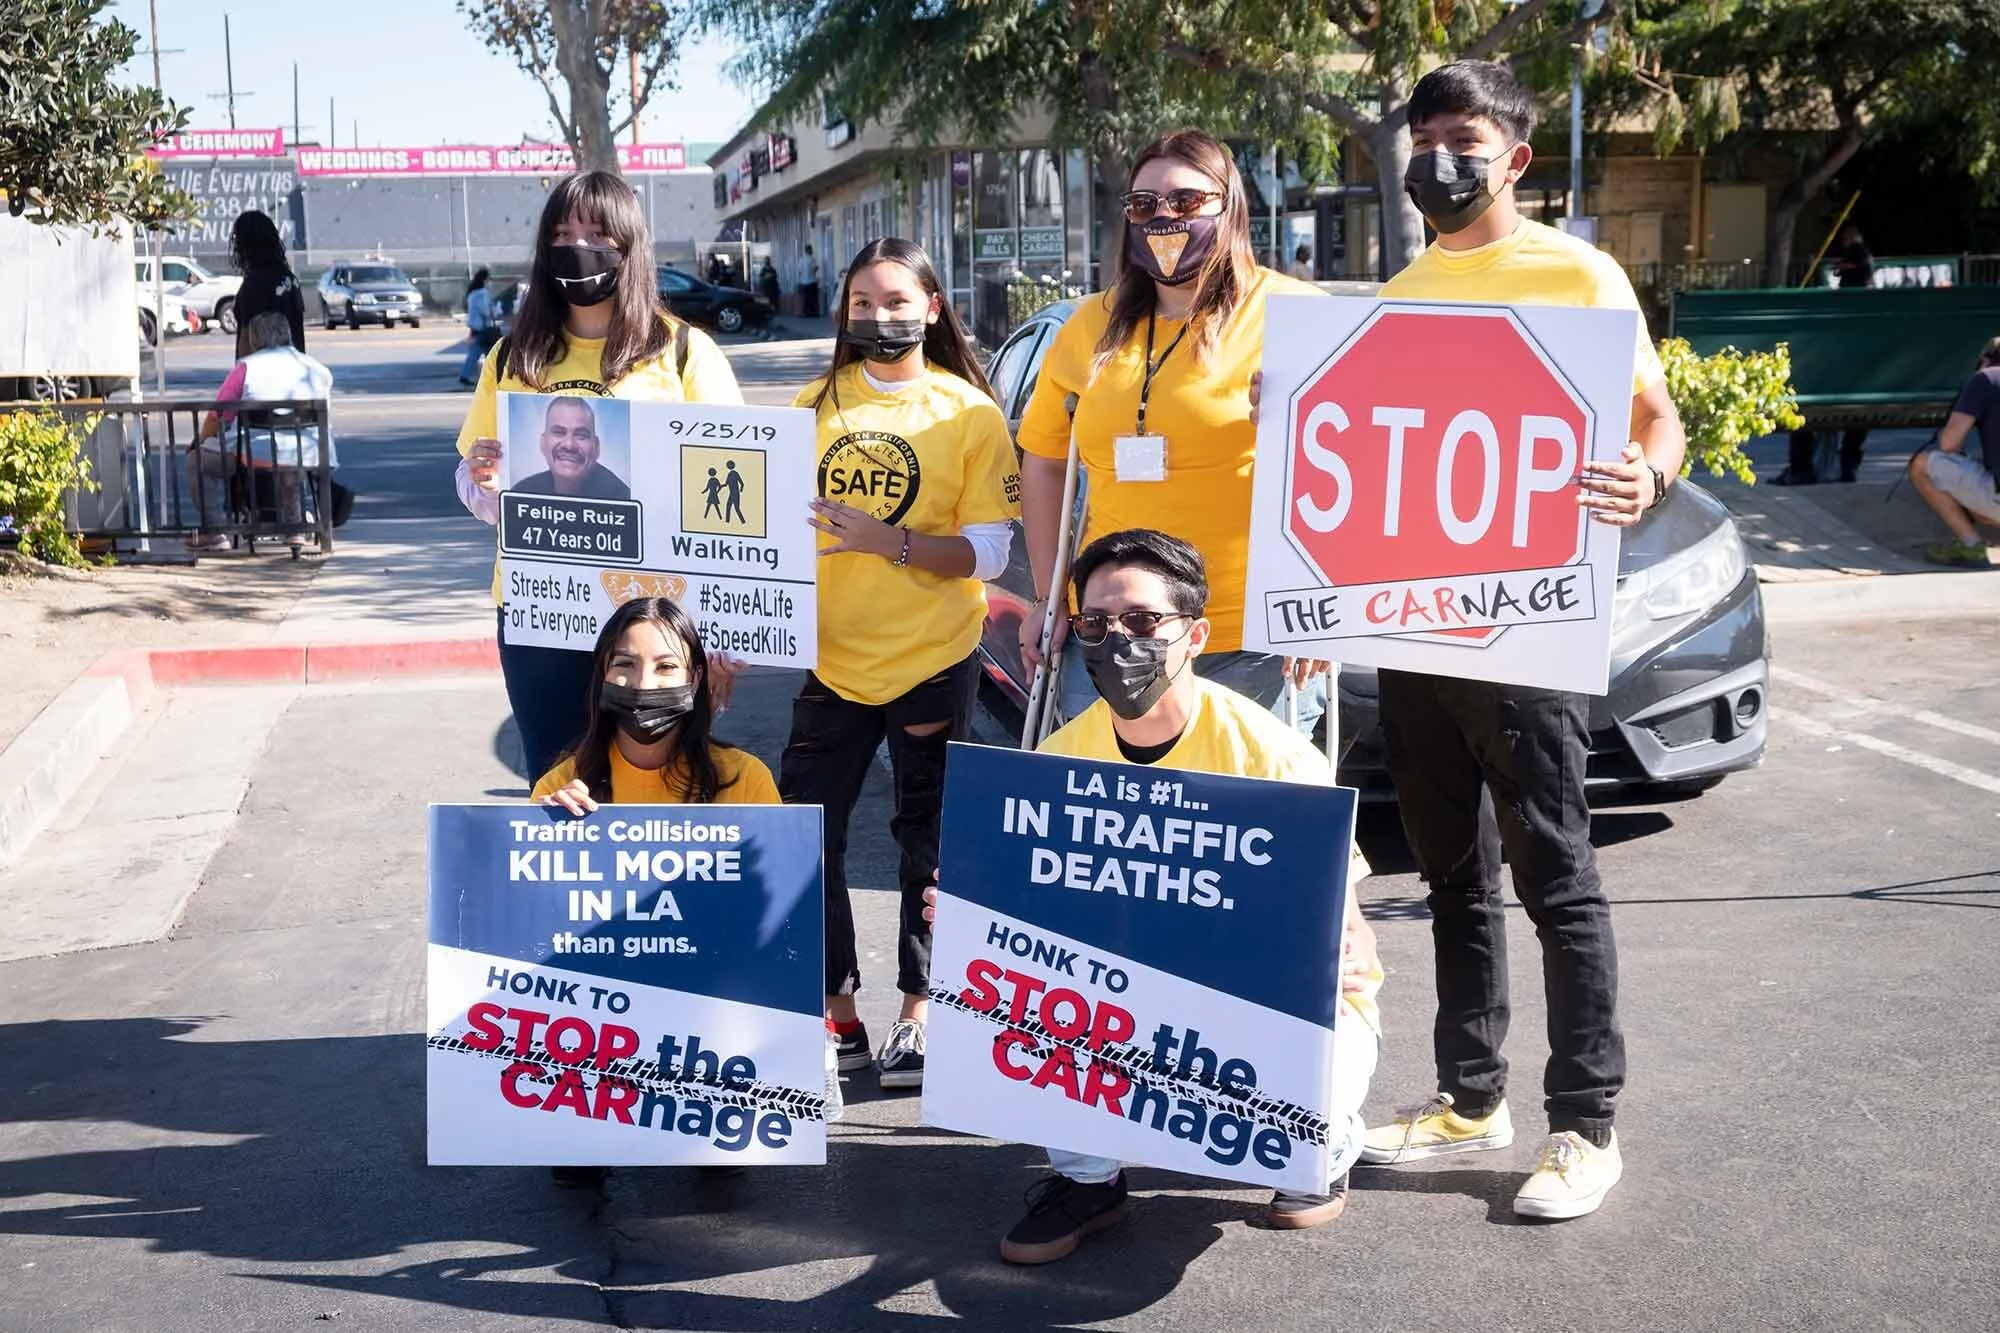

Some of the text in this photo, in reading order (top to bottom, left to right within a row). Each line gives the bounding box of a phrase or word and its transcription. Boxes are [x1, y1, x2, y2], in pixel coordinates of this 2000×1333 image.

[179, 133, 276, 151] CEREMONY
[300, 150, 409, 170] WEDDINGS
[422, 150, 491, 170] BODAS
[642, 148, 684, 168] FILM
[985, 234, 1006, 244] PAY
[669, 420, 777, 441] 9/25/19
[874, 432, 918, 477] CALIFORNIA
[830, 467, 905, 498] SAFE
[1296, 400, 1579, 549] STOP
[517, 503, 625, 526] Felipe Ruiz
[521, 526, 621, 552] 47 Years Old
[671, 535, 779, 570] Walking
[511, 570, 591, 602] Streets Are
[700, 583, 794, 619] #SaveALife
[1273, 574, 1580, 633] THE CARNAGE
[502, 601, 598, 641] For Everyone
[698, 620, 797, 657] #SpeedKills
[1066, 769, 1209, 812] LA is #1...
[510, 819, 741, 843] Traffic Collisions
[1003, 798, 1275, 867] IN TRAFFIC
[509, 850, 741, 882] KILL MORE
[1031, 848, 1235, 911] DEATHS.
[568, 890, 684, 921] IN LA
[552, 931, 615, 955] than
[986, 922, 1130, 994] HONK TO
[486, 966, 631, 1015] HONK TO
[461, 1001, 757, 1091] STOP the
[960, 958, 1257, 1100] STOP the
[500, 1062, 793, 1153] CARnage
[992, 1028, 1292, 1170] CARnage
